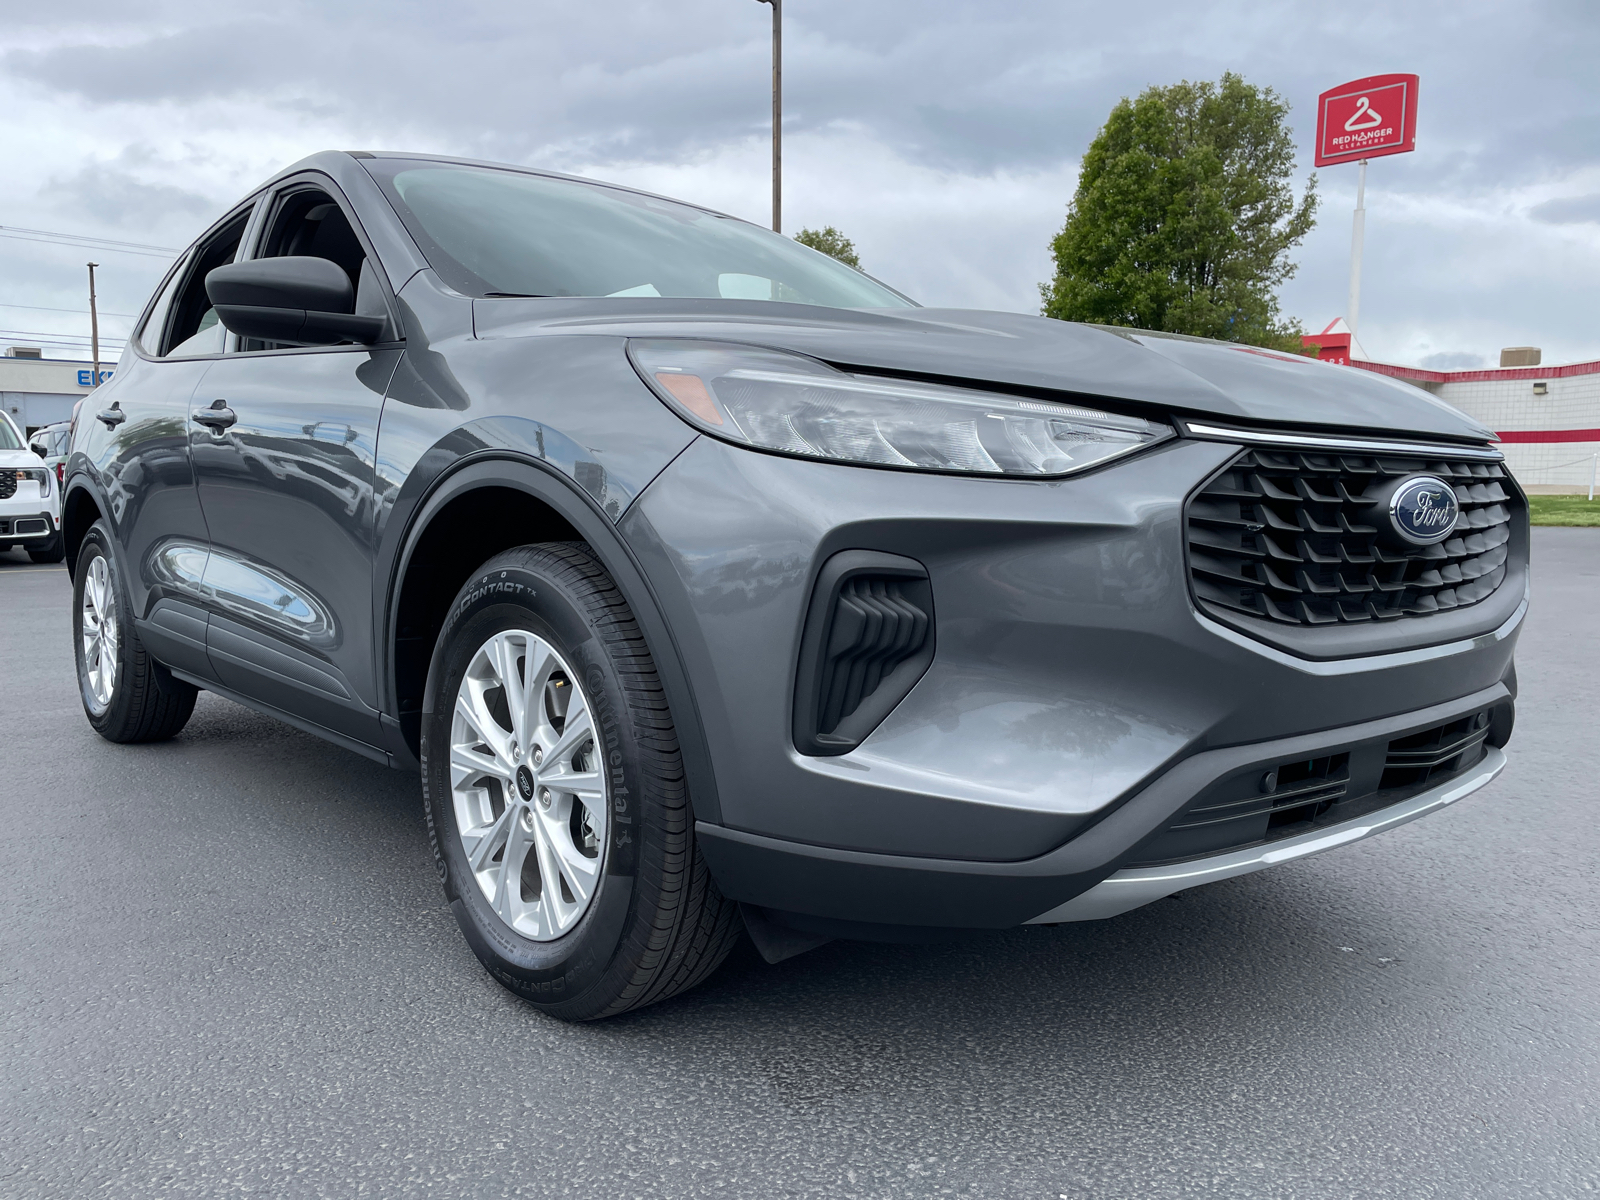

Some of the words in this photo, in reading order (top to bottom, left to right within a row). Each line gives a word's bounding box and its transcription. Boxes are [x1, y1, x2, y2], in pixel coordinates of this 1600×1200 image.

[1332, 135, 1351, 145] RED
[1352, 127, 1393, 141] HANGER
[1340, 137, 1384, 150] CLEANERS
[1413, 490, 1449, 527] Ford
[586, 663, 633, 825] Continental
